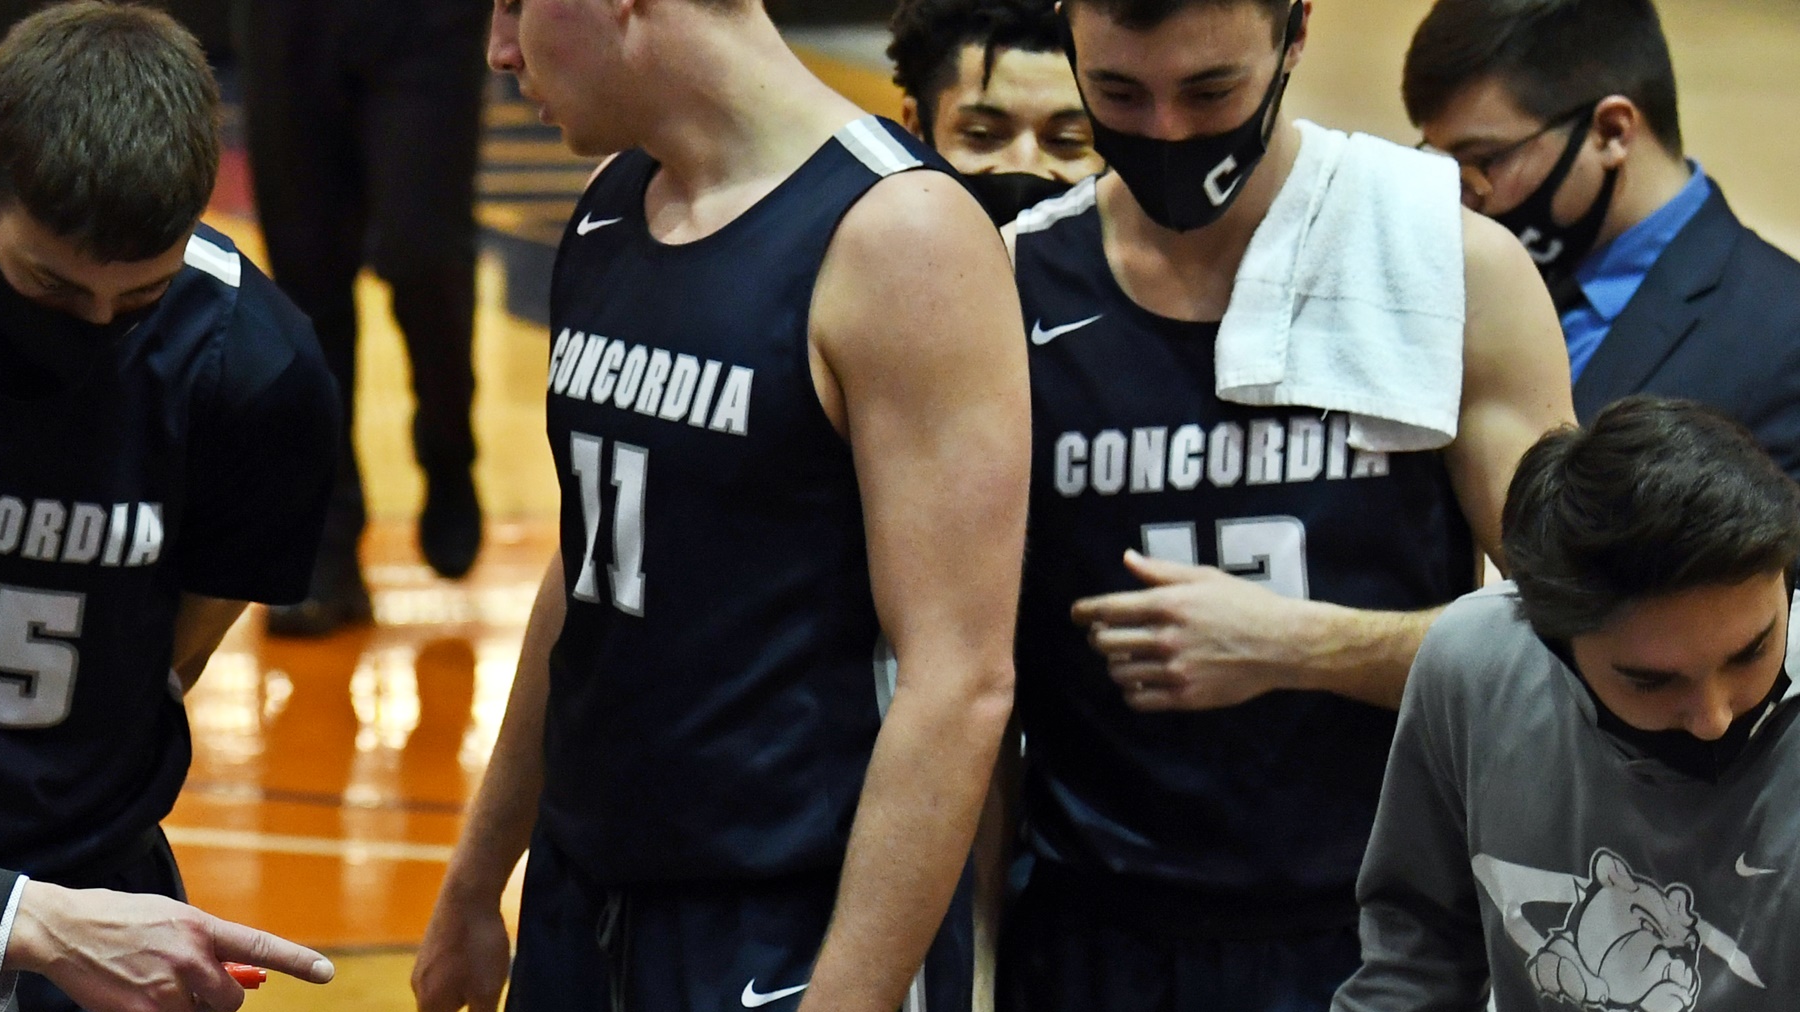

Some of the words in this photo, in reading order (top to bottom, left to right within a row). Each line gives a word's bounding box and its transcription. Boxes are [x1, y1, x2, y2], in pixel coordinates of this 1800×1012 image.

[1203, 154, 1242, 206] C
[547, 327, 754, 436] CONCORDIA
[570, 430, 650, 618] 11
